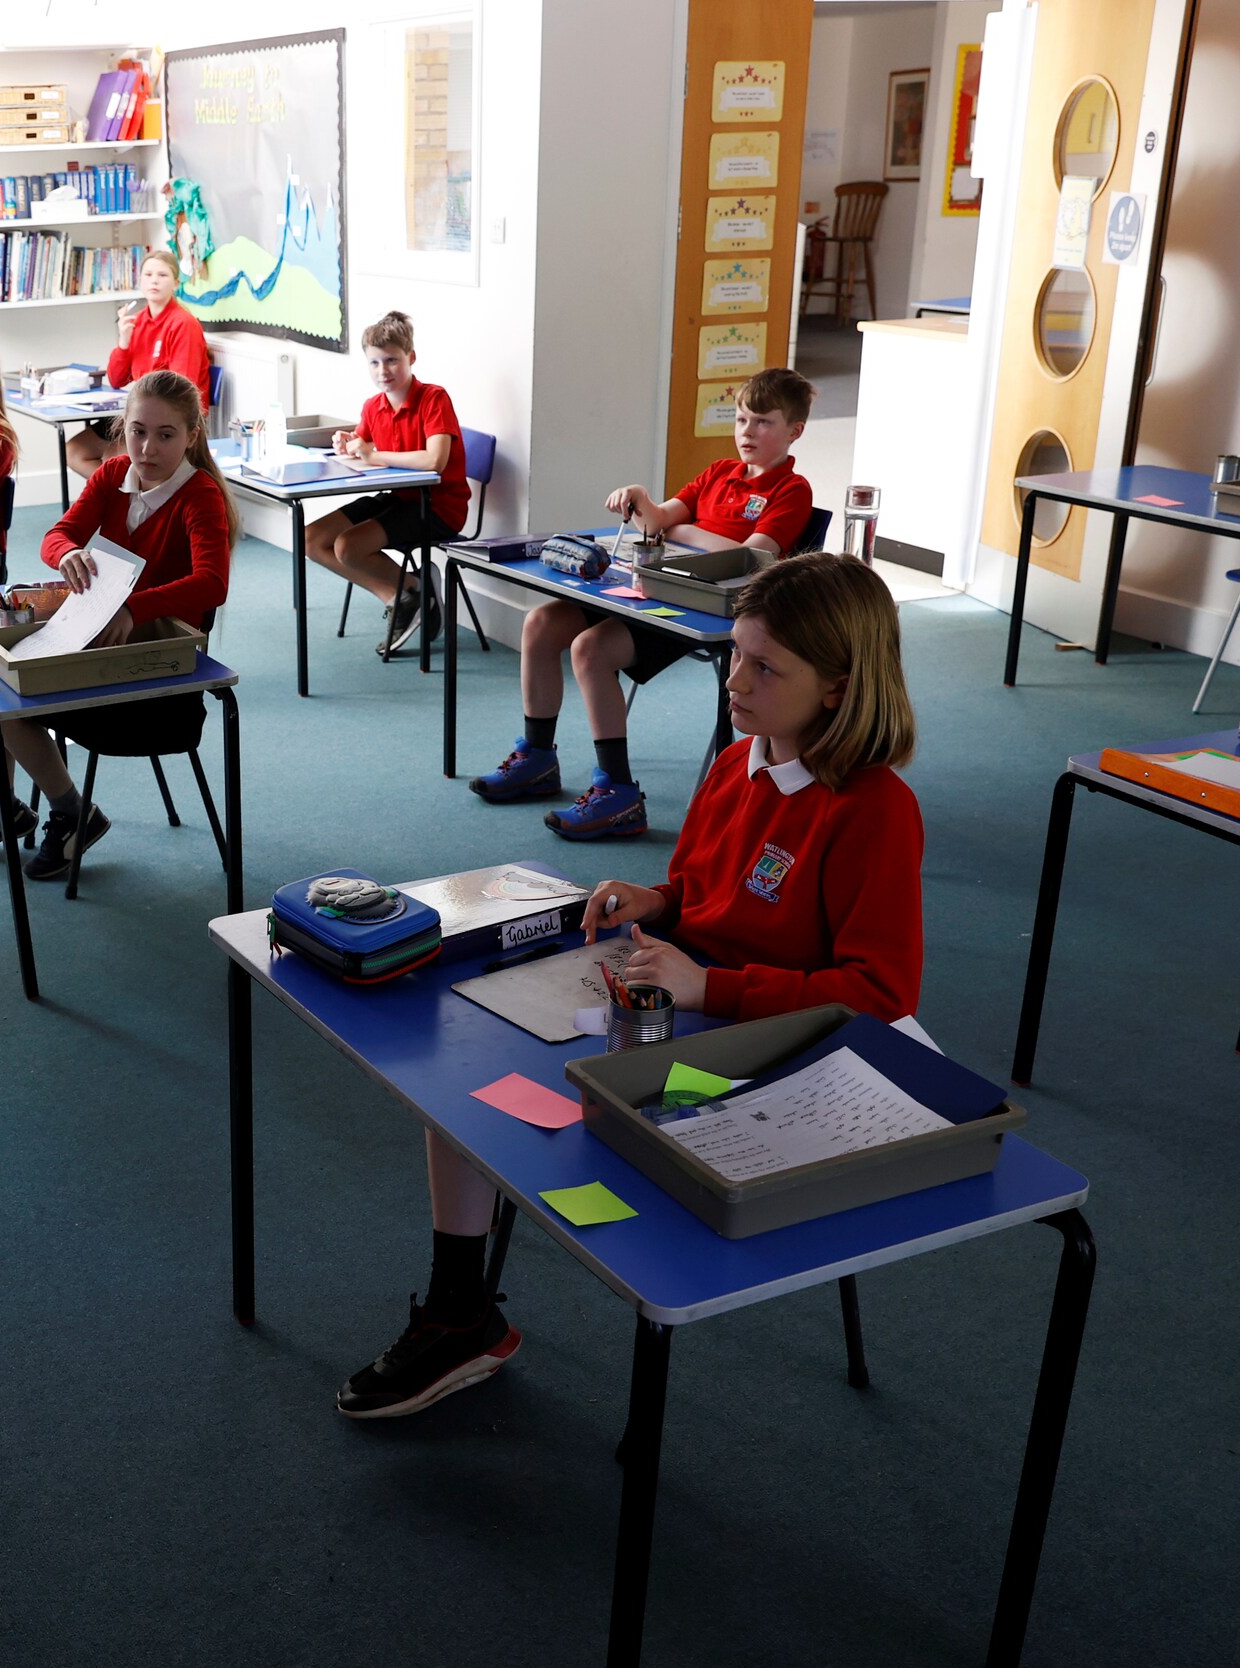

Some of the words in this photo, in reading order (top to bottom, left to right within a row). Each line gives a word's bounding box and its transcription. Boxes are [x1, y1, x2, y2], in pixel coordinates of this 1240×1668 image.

[199, 62, 256, 93] Journey
[194, 98, 238, 125] Middle
[247, 94, 287, 125] Earth
[505, 914, 559, 947] Gabriel
